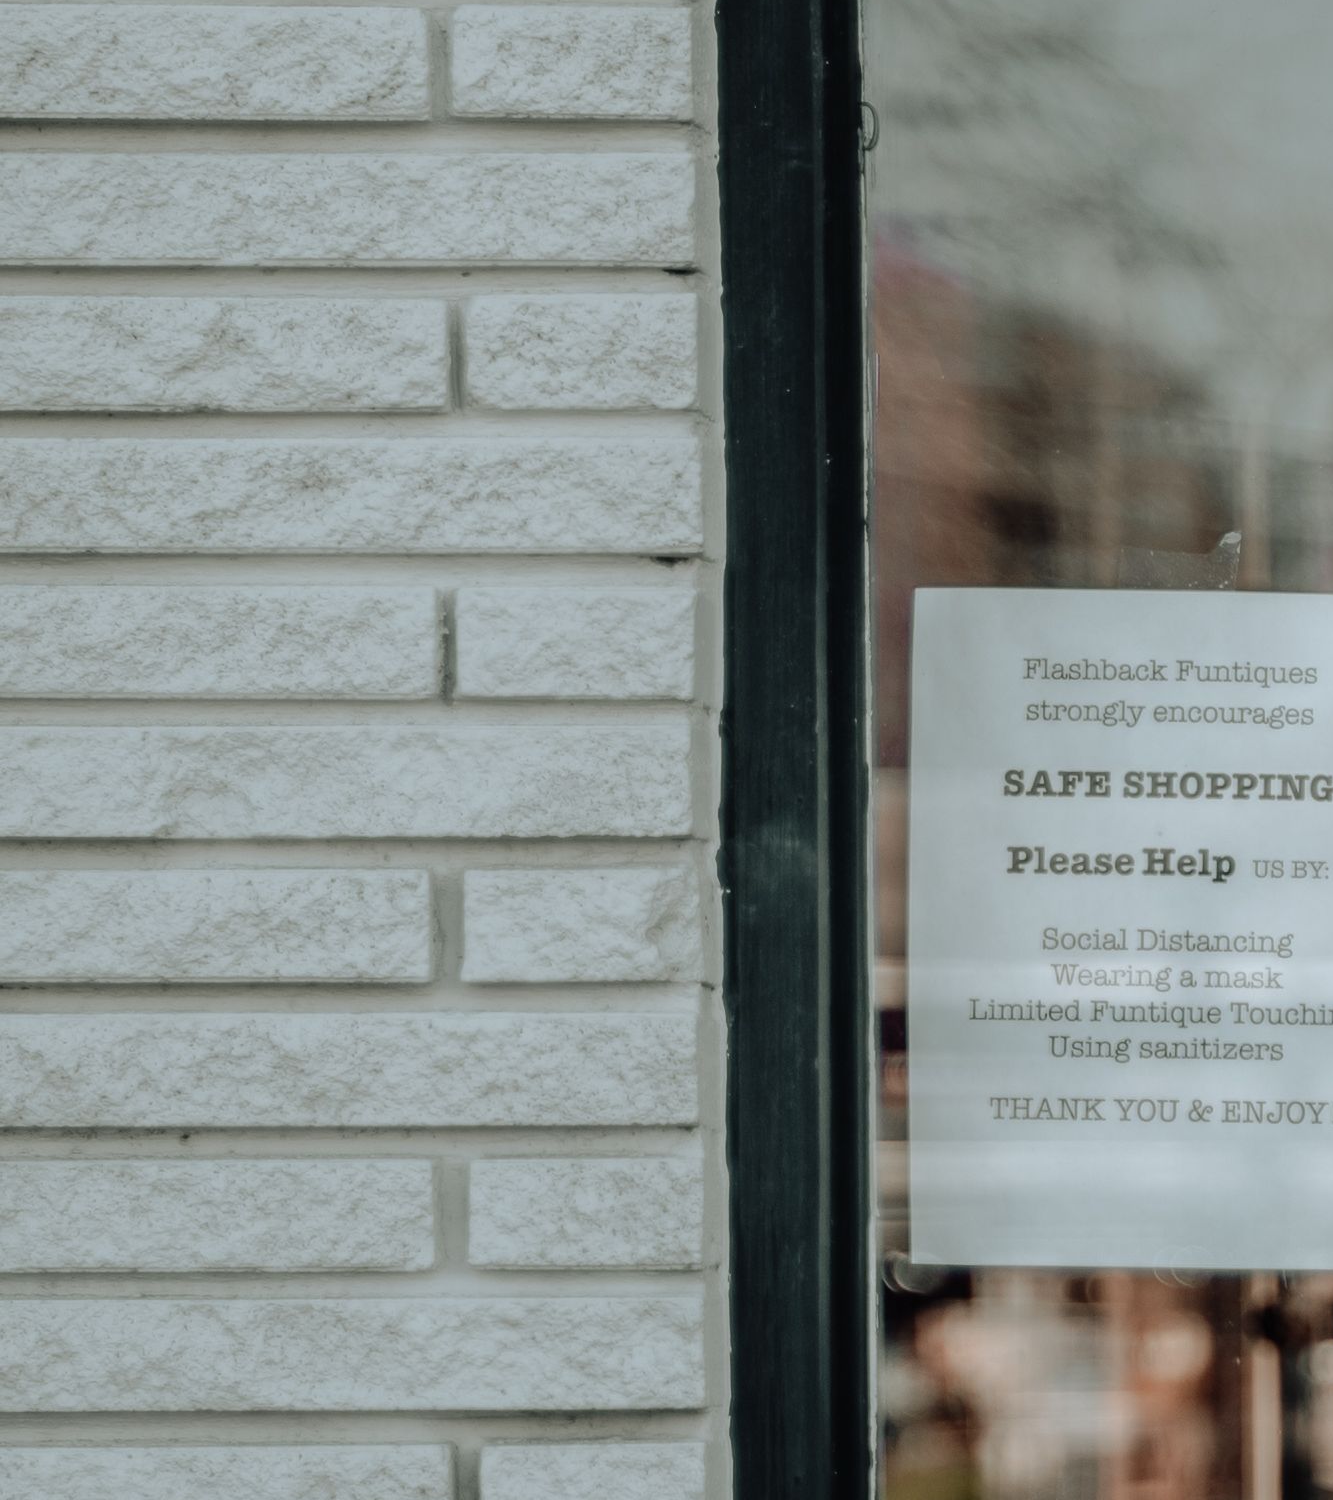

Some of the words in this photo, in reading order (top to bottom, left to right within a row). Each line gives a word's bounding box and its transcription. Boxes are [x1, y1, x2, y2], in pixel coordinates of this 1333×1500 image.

[1023, 658, 1168, 682] Flashback
[1176, 660, 1318, 688] Funtiques
[1026, 700, 1146, 727] strongly
[1153, 704, 1314, 729] encourages
[1003, 769, 1112, 797] SAFE
[1007, 846, 1135, 874] Please
[1142, 848, 1236, 881] Help
[1253, 860, 1284, 879] US
[1291, 860, 1329, 879] BY:
[1041, 928, 1128, 951] Social
[1137, 929, 1294, 958] Distancing
[1051, 963, 1173, 992] Wearing
[1179, 970, 1197, 987] a
[1204, 967, 1284, 989] mask
[969, 999, 1082, 1021] Limited
[1090, 1001, 1222, 1028] Funtique
[1048, 1036, 1132, 1063] Using
[1138, 1038, 1284, 1061] sanitizers
[990, 1097, 1106, 1121] THANK
[1114, 1099, 1179, 1122] YOU
[1188, 1100, 1214, 1122] &
